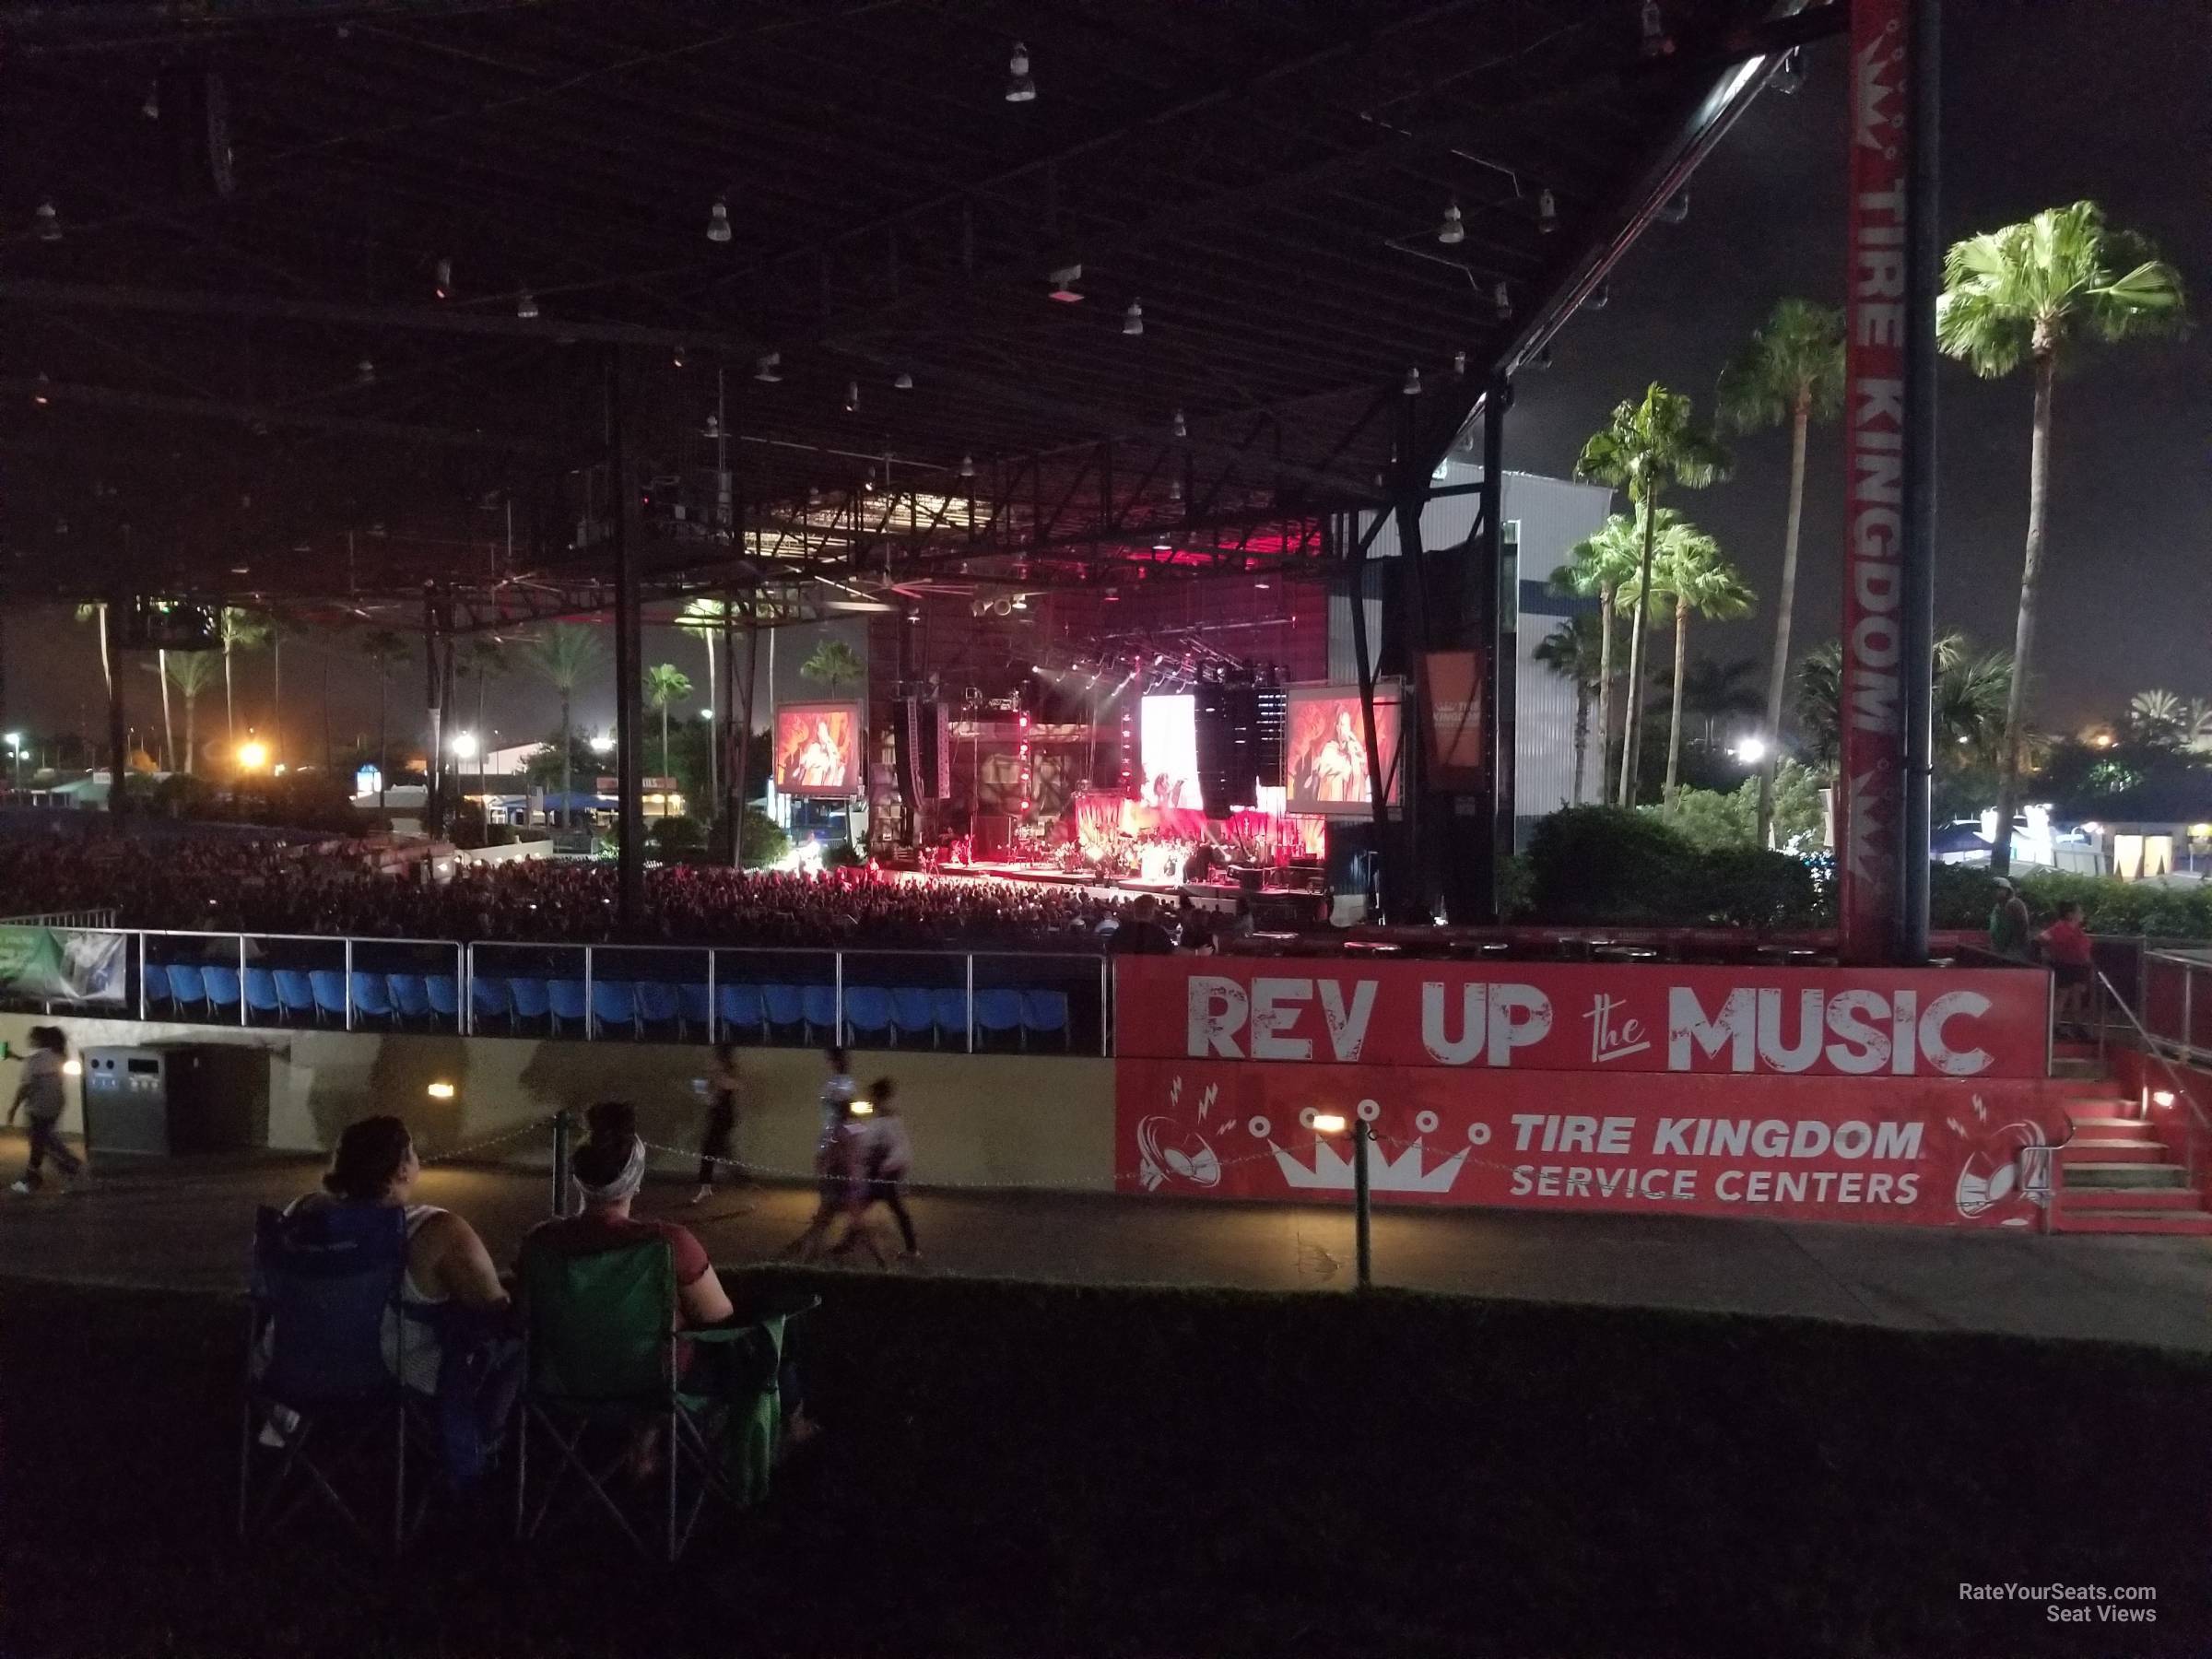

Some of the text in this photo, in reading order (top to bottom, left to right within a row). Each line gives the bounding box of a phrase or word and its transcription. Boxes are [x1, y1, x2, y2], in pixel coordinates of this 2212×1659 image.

[1852, 179, 1906, 734] TIRE KINGDOM
[1187, 975, 1994, 1076] REV UP the MUSIC
[1511, 1113, 1925, 1159] TIRE KINGDOM
[1510, 1164, 1922, 1205] SERVICE CENTERS
